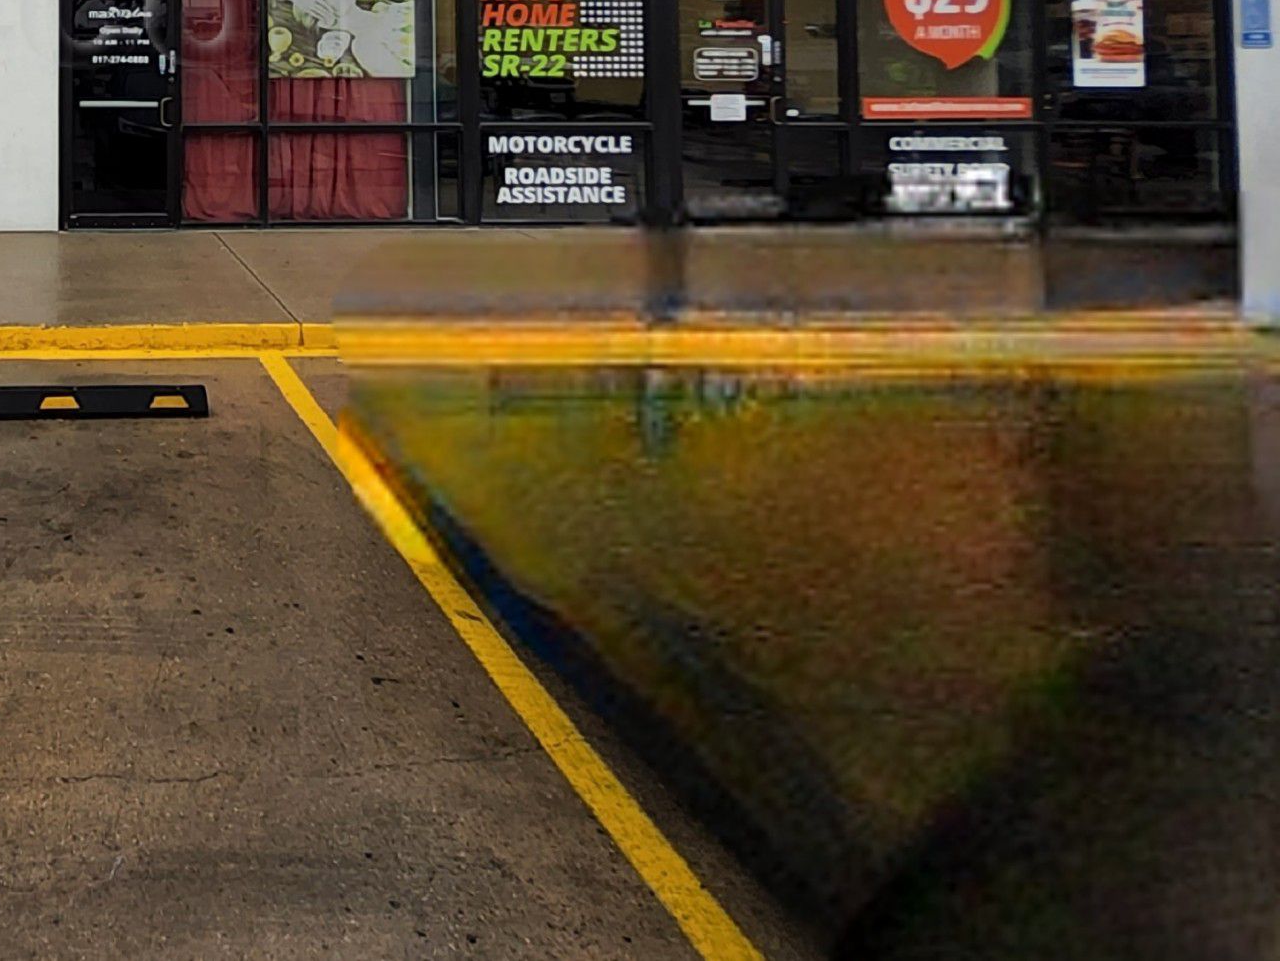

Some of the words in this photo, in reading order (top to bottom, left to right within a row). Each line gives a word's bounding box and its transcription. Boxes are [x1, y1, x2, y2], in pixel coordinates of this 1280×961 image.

[482, 4, 578, 28] HOME
[483, 29, 619, 53] RENTERS
[482, 55, 566, 78] SR-22
[488, 136, 633, 153] MOTORCYCLE
[504, 167, 612, 184] ROADSIDE
[496, 186, 626, 203] ASSISTANCE
